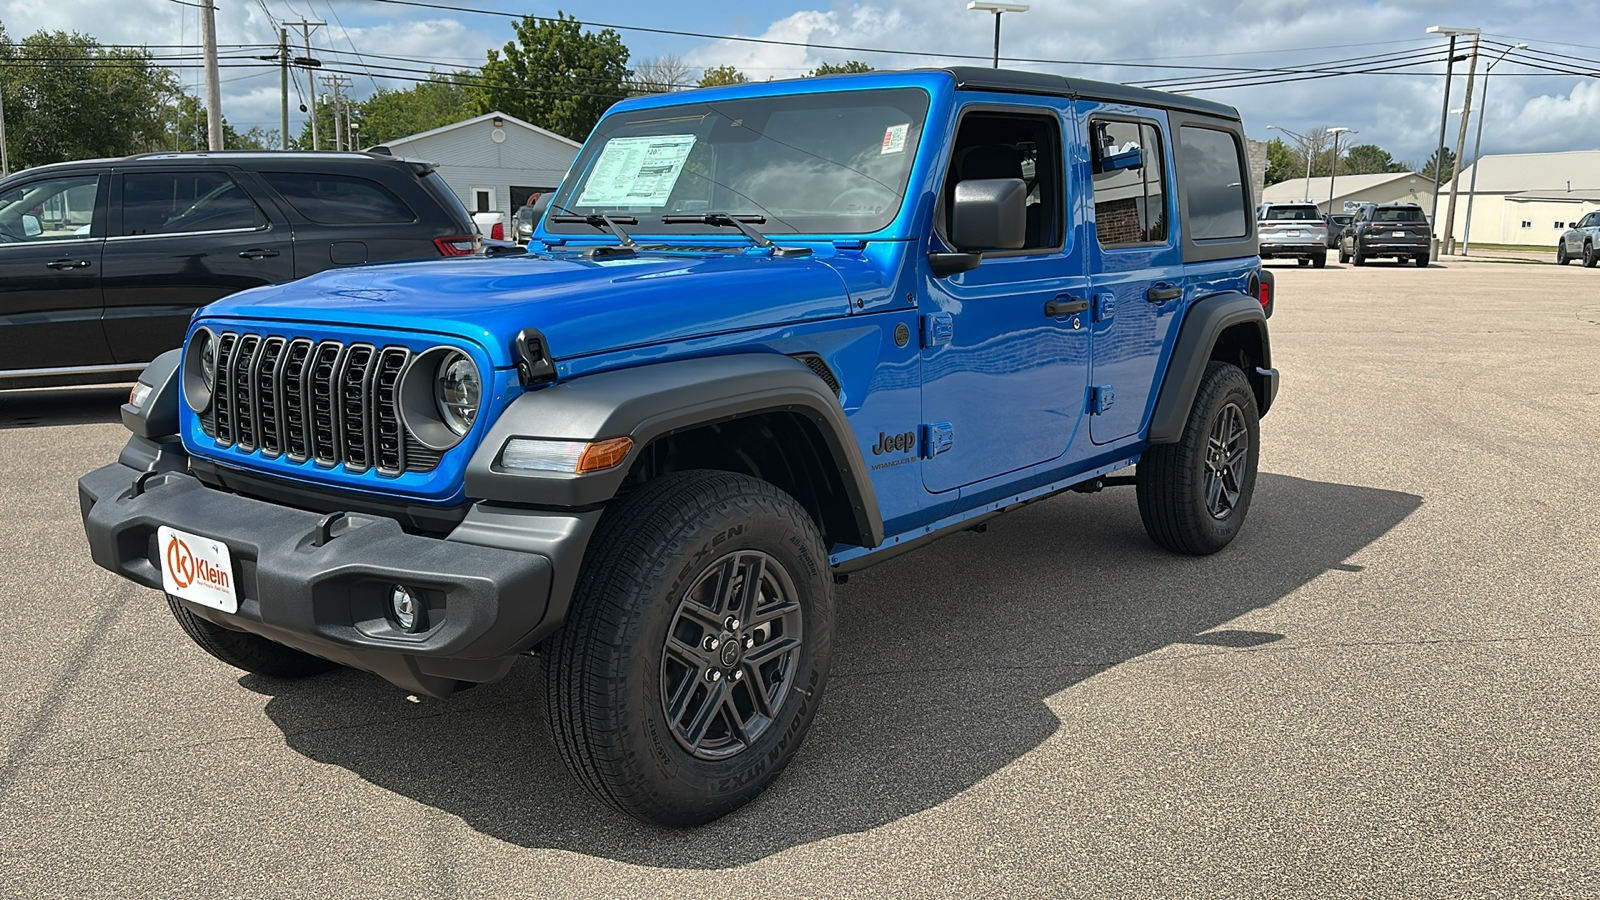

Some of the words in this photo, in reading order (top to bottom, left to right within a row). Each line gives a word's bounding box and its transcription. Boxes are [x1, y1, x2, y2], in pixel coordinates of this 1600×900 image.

[872, 432, 916, 455] Jeep
[871, 458, 910, 471] WRANGLER
[665, 524, 744, 605] NEXEN
[788, 535, 818, 577] All-Weather
[195, 557, 229, 588] Klein
[770, 669, 819, 766] ROADIAN
[718, 762, 767, 793] HTX2
